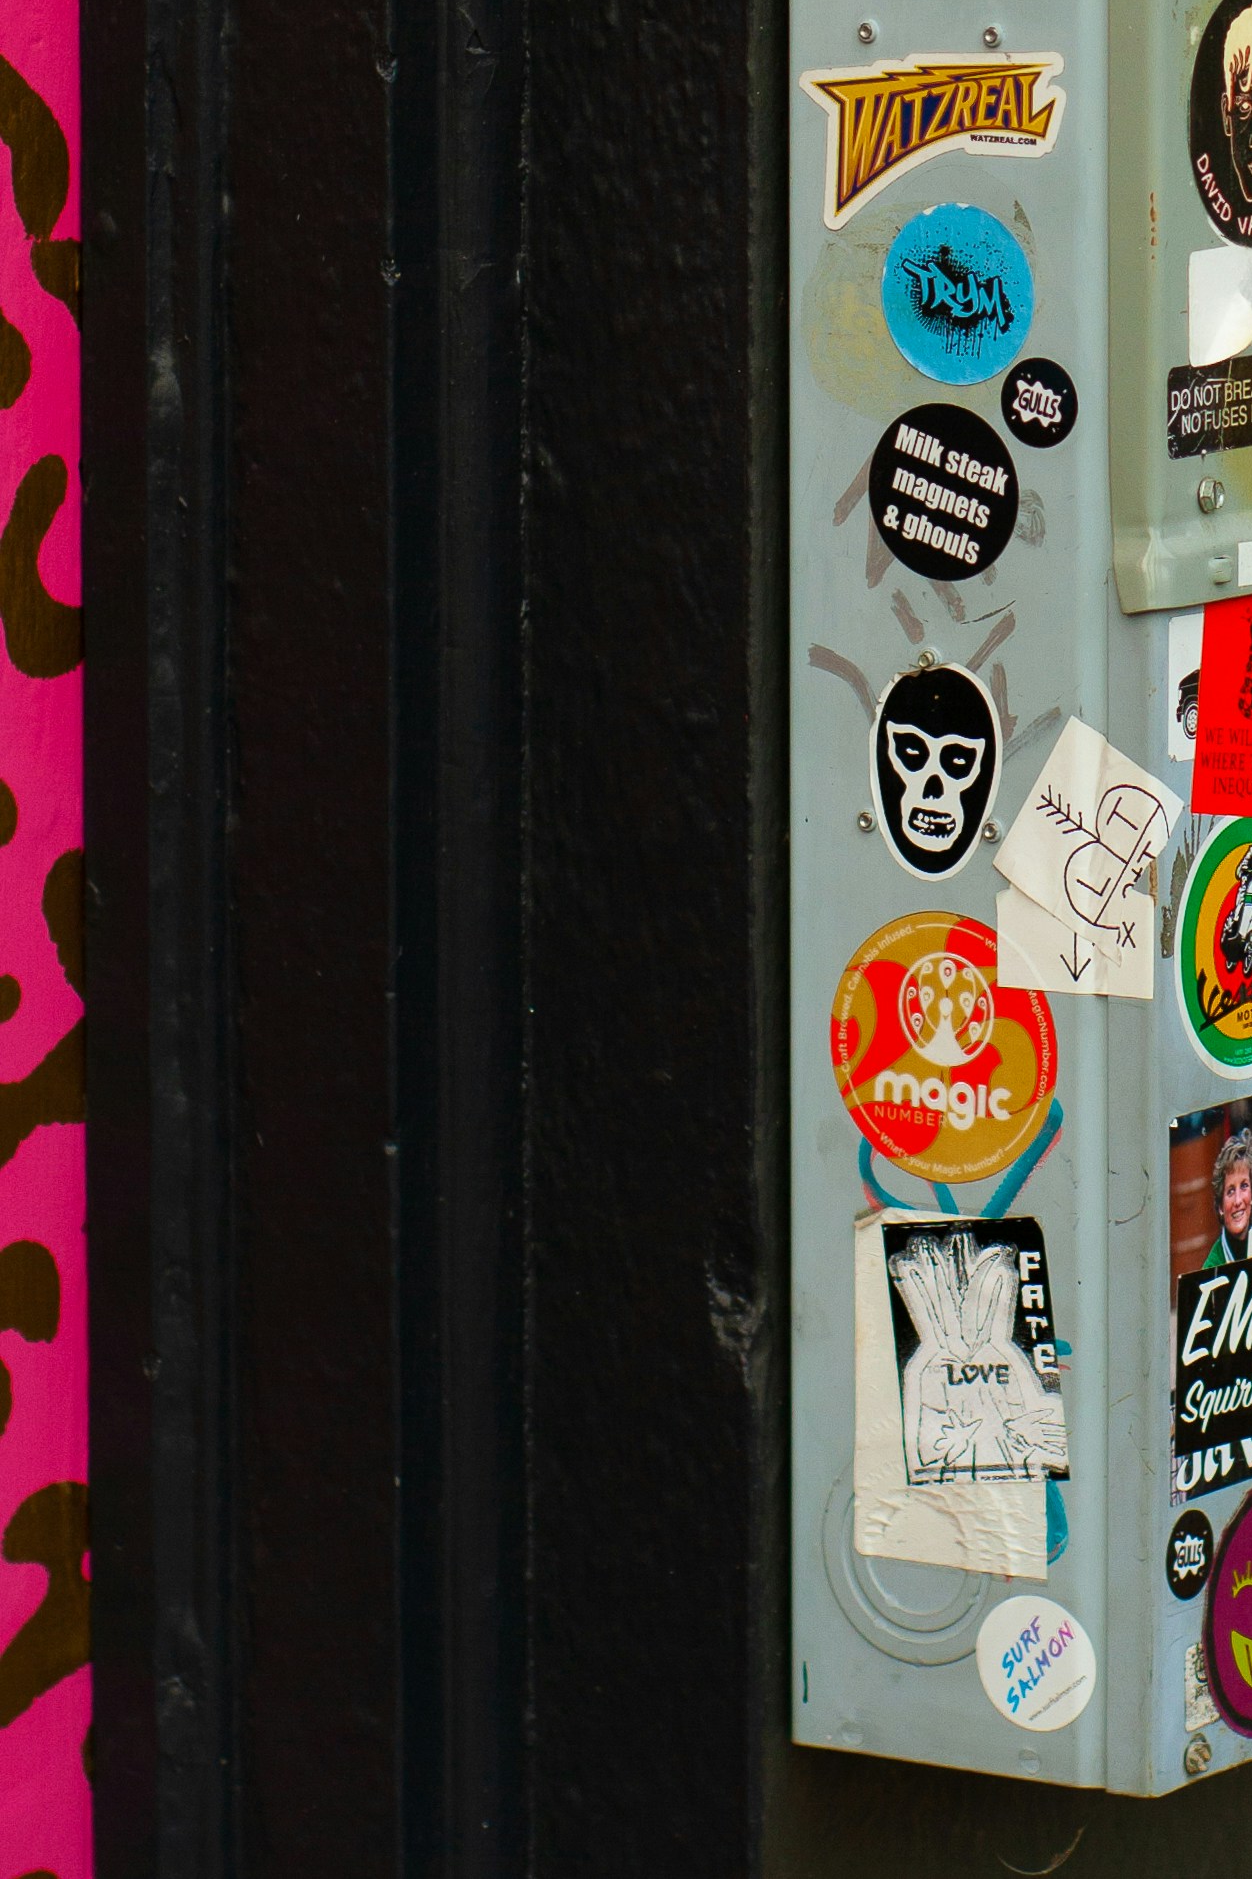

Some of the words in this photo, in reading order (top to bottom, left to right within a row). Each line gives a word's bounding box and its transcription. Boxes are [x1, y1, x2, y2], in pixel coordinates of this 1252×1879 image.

[811, 64, 1057, 216] WATZREAL
[970, 134, 1037, 146] WATZREAL.COM
[1196, 152, 1232, 222] DAVID
[902, 257, 1008, 328] TRYM
[1018, 387, 1060, 419] GULLS
[1171, 389, 1192, 412] DO
[1194, 384, 1220, 407] NOT
[1181, 412, 1201, 435] NO
[1203, 404, 1248, 430] FUSES
[894, 423, 943, 468] Milk
[945, 448, 1009, 496] steak
[892, 467, 991, 529] magnets
[883, 504, 899, 530] &
[902, 513, 981, 565] ghouls
[1200, 751, 1246, 771] WHERE
[1203, 726, 1224, 746] WE
[840, 1046, 850, 1073] Craft
[847, 944, 880, 991] Cannabis
[874, 1069, 1013, 1131] magic
[874, 1105, 948, 1128] NUMBER
[908, 1154, 931, 1169] your
[932, 1162, 962, 1177] Magic
[1018, 1251, 1061, 1374] FATE
[945, 1363, 1010, 1386] LOVE
[1001, 1615, 1041, 1679] SURF
[1005, 1620, 1077, 1714] SALMON
